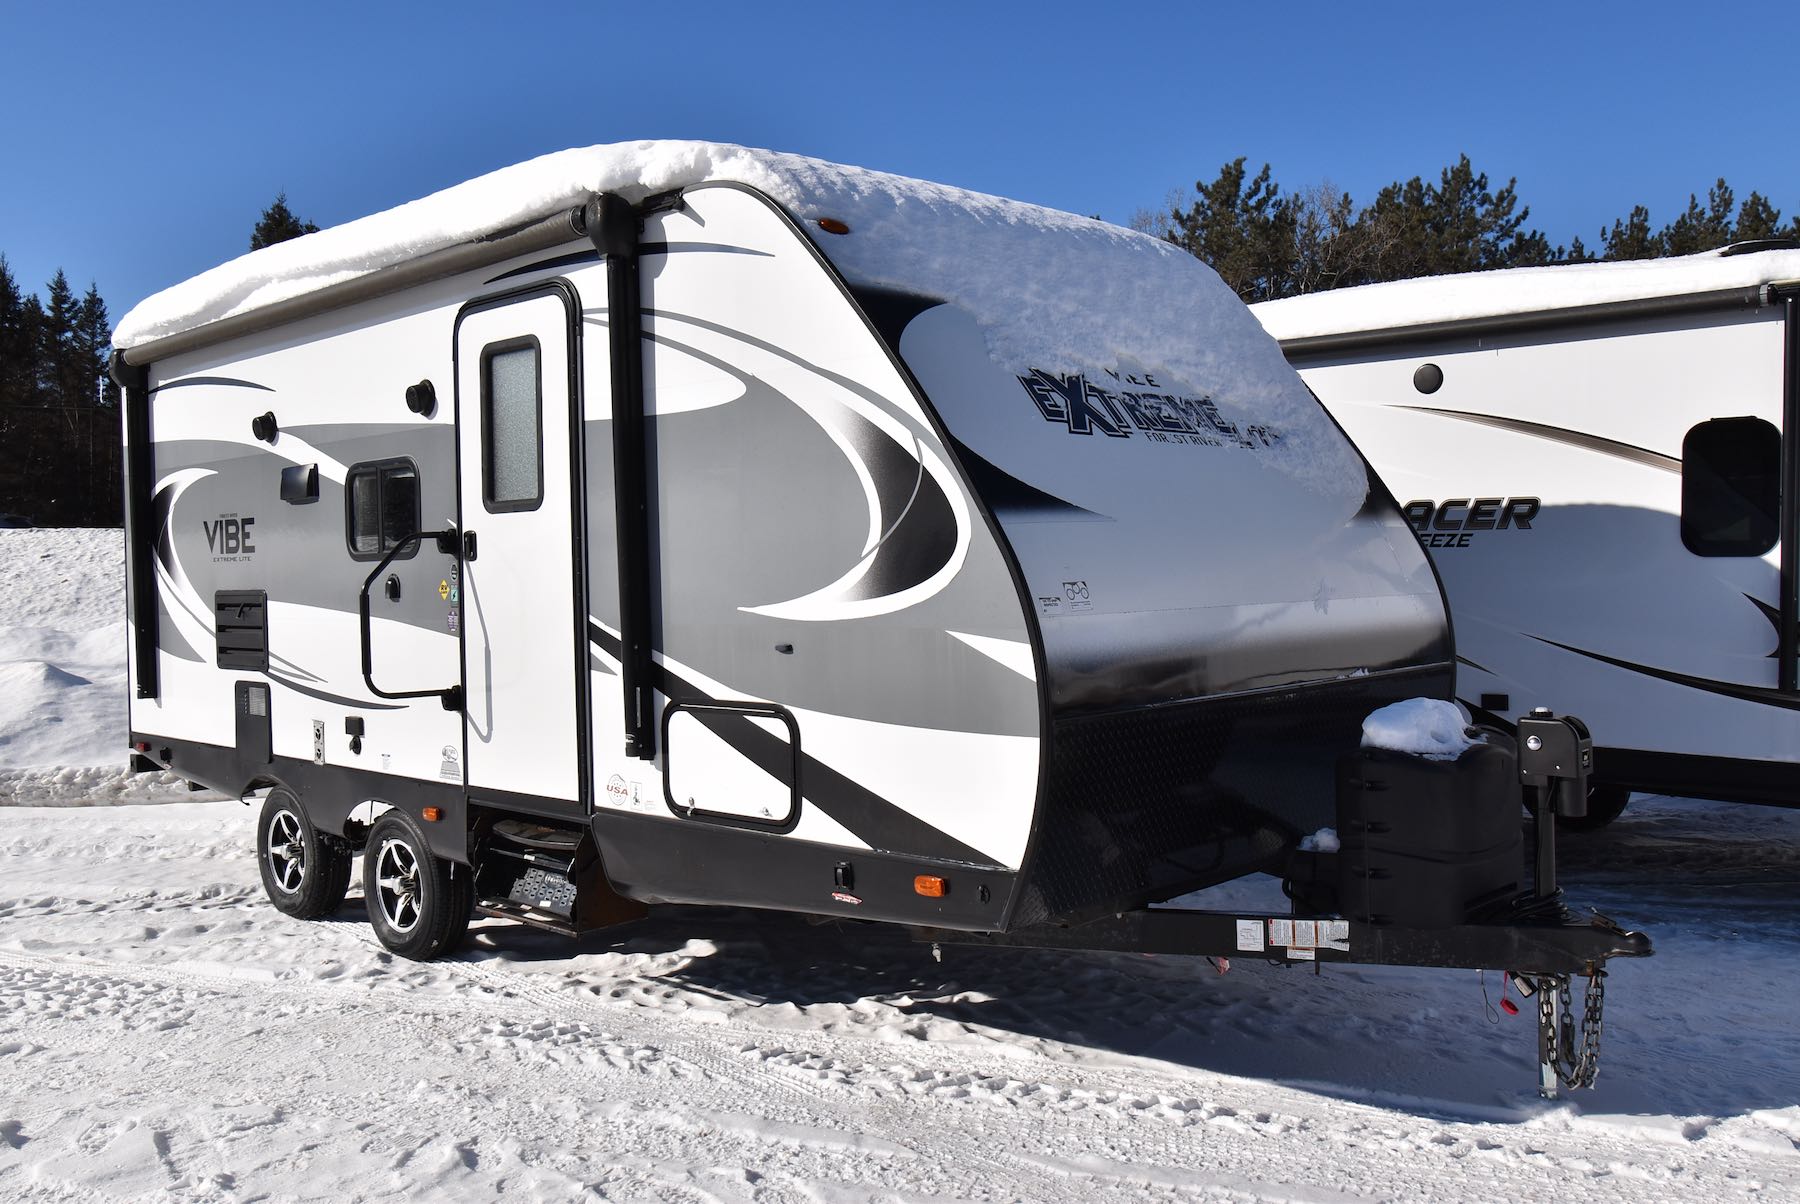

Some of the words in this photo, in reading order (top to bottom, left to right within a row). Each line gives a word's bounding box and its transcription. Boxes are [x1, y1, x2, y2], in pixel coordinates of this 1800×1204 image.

[1016, 366, 1236, 438] EXTREME
[1402, 497, 1541, 531] ACER
[203, 517, 255, 554] VIBE
[1419, 533, 1474, 547] EEZE
[606, 784, 628, 796] USA
